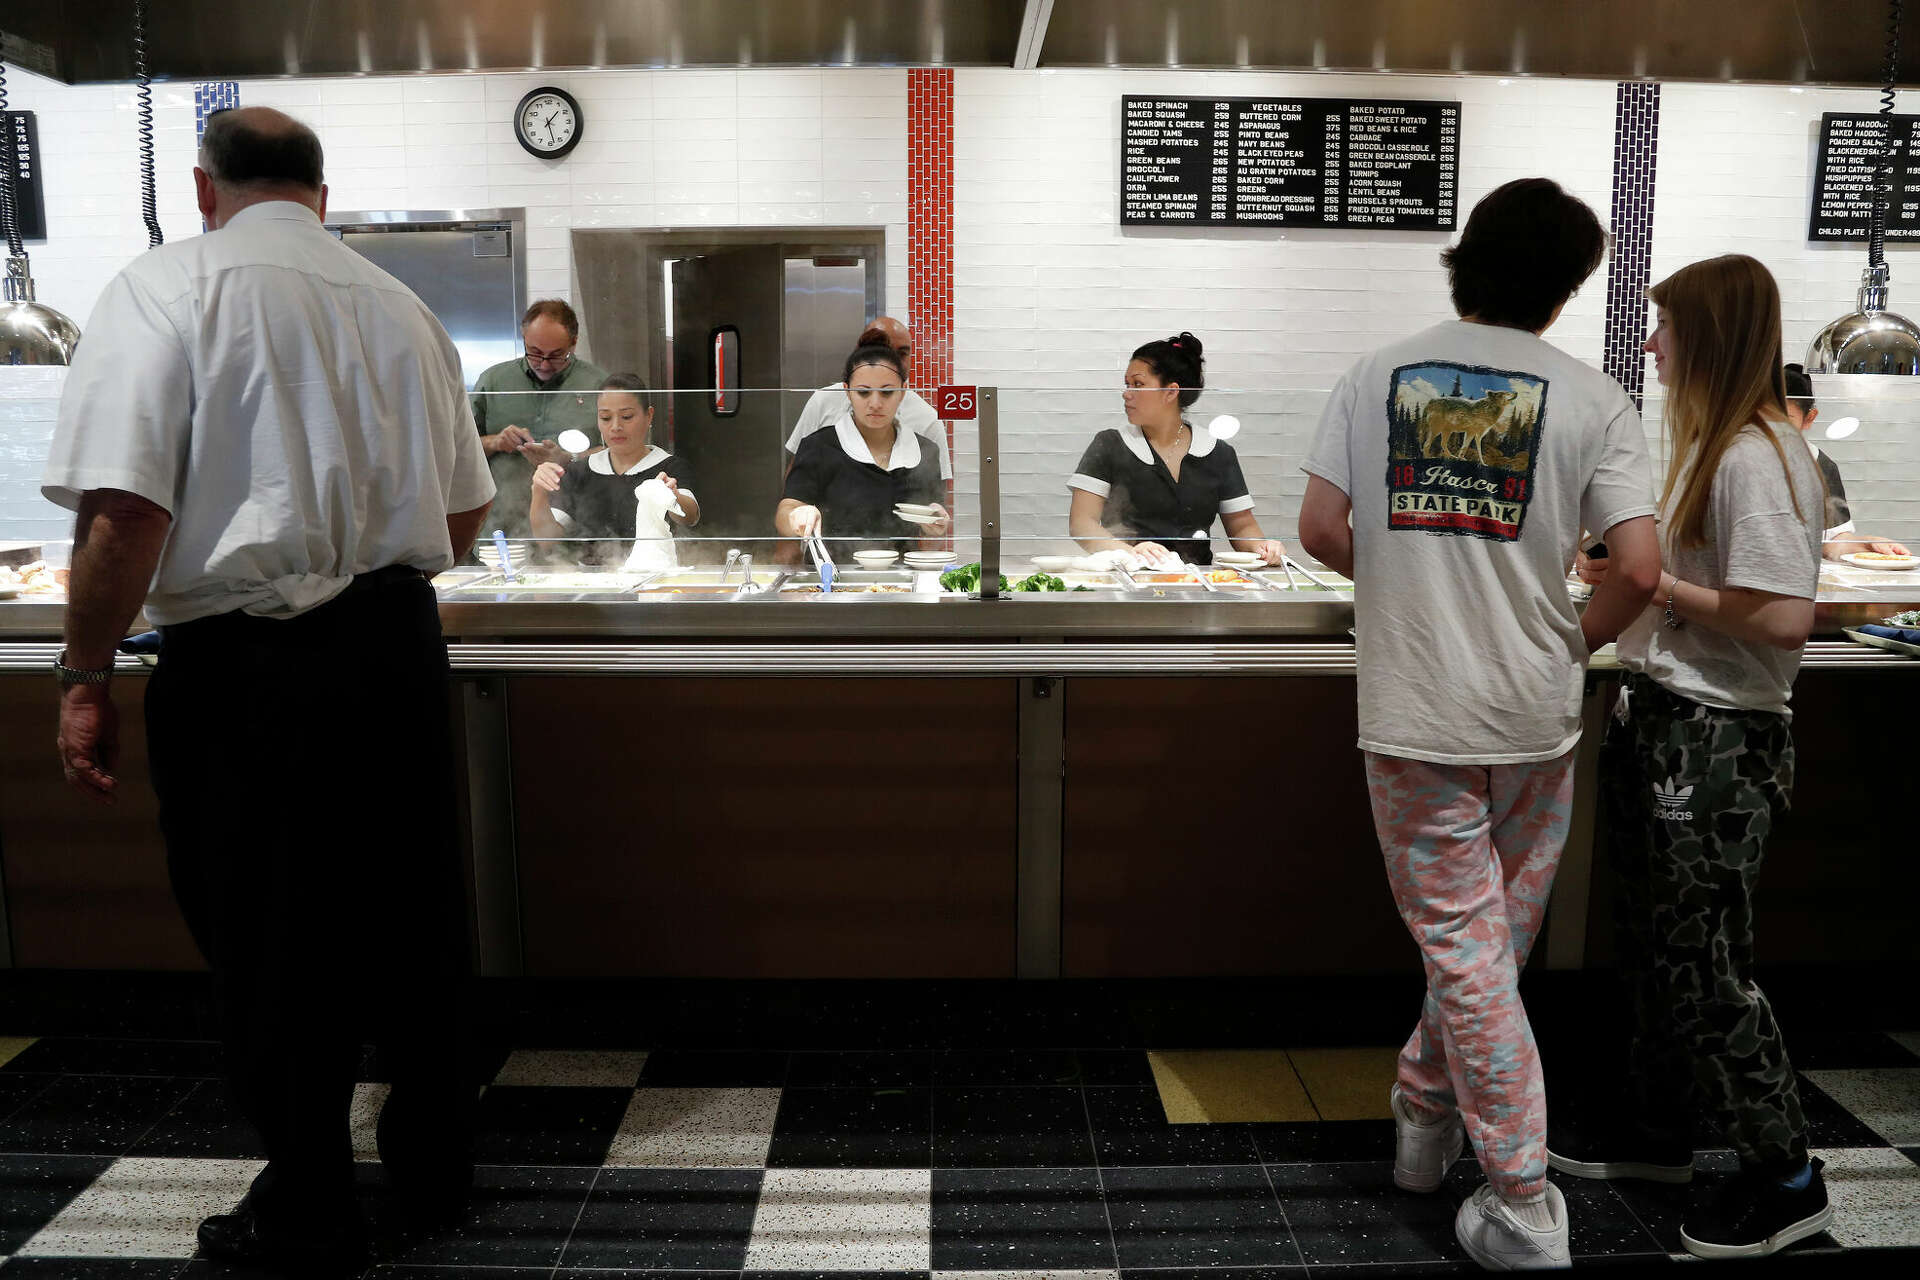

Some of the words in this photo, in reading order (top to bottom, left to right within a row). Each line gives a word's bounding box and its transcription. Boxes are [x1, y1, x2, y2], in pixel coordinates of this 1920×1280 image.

[1128, 101, 1153, 109] BAKED
[1155, 102, 1188, 110] SPINACH
[1252, 104, 1302, 112] VEGETABLES
[1127, 110, 1153, 118] BAKED
[1155, 111, 1185, 119] SQUASH
[1239, 112, 1278, 120] BUTTERED
[1281, 113, 1301, 121] CORN
[1350, 115, 1374, 123] BAKED
[1168, 120, 1173, 128] &
[1239, 122, 1281, 130] ASPARAGUS
[1831, 120, 1853, 128] FRIED
[1127, 129, 1159, 137] CANDIED
[1265, 131, 1289, 139] BEANS
[1830, 129, 1853, 137] BAKED
[1127, 138, 1158, 146] MASHED
[1260, 140, 1285, 148] BEANS
[1829, 138, 1860, 146] POACHED
[1127, 147, 1145, 155] RICE
[1387, 144, 1429, 152] CASSEROLE
[1828, 147, 1869, 155] BLACKENED
[1238, 149, 1262, 157] BLACK
[1284, 150, 1304, 158] PEAS
[1395, 153, 1436, 161] CASSEROLE
[1127, 156, 1153, 164] GREEN
[1238, 158, 1254, 166] NEW
[1257, 158, 1295, 166] POTATOES
[1827, 156, 1846, 164] WITH
[1237, 167, 1248, 175] AU
[1278, 168, 1316, 176] POTATOES
[1826, 165, 1847, 173] FRIED
[1349, 170, 1379, 178] TURNIPS
[1825, 174, 1872, 182] HUSHPUPPIES
[1126, 175, 1180, 183] CAULIFLOWER
[1237, 176, 1262, 184] BAKED
[1237, 185, 1266, 193] GREENS
[1824, 183, 1864, 191] BLACKENED
[1280, 195, 1315, 203] DRESSING
[1348, 197, 1387, 205] BRUSSELS
[1389, 198, 1423, 206] SPROUTS
[1126, 202, 1162, 210] STEAMED
[1164, 202, 1197, 210] SPINACH
[1236, 203, 1282, 211] BUTTERNUT
[1285, 204, 1315, 212] SQUASH
[1160, 211, 1195, 219] CARROTS
[1397, 207, 1434, 215] TOMATOES
[1820, 210, 1849, 218] SALMON
[1236, 212, 1284, 220] MUSHROOMS
[1844, 228, 1865, 236] PLATE
[944, 393, 973, 410] 25
[1419, 465, 1499, 494] Itasca
[1503, 477, 1527, 501] 91
[1397, 494, 1462, 512] STATE
